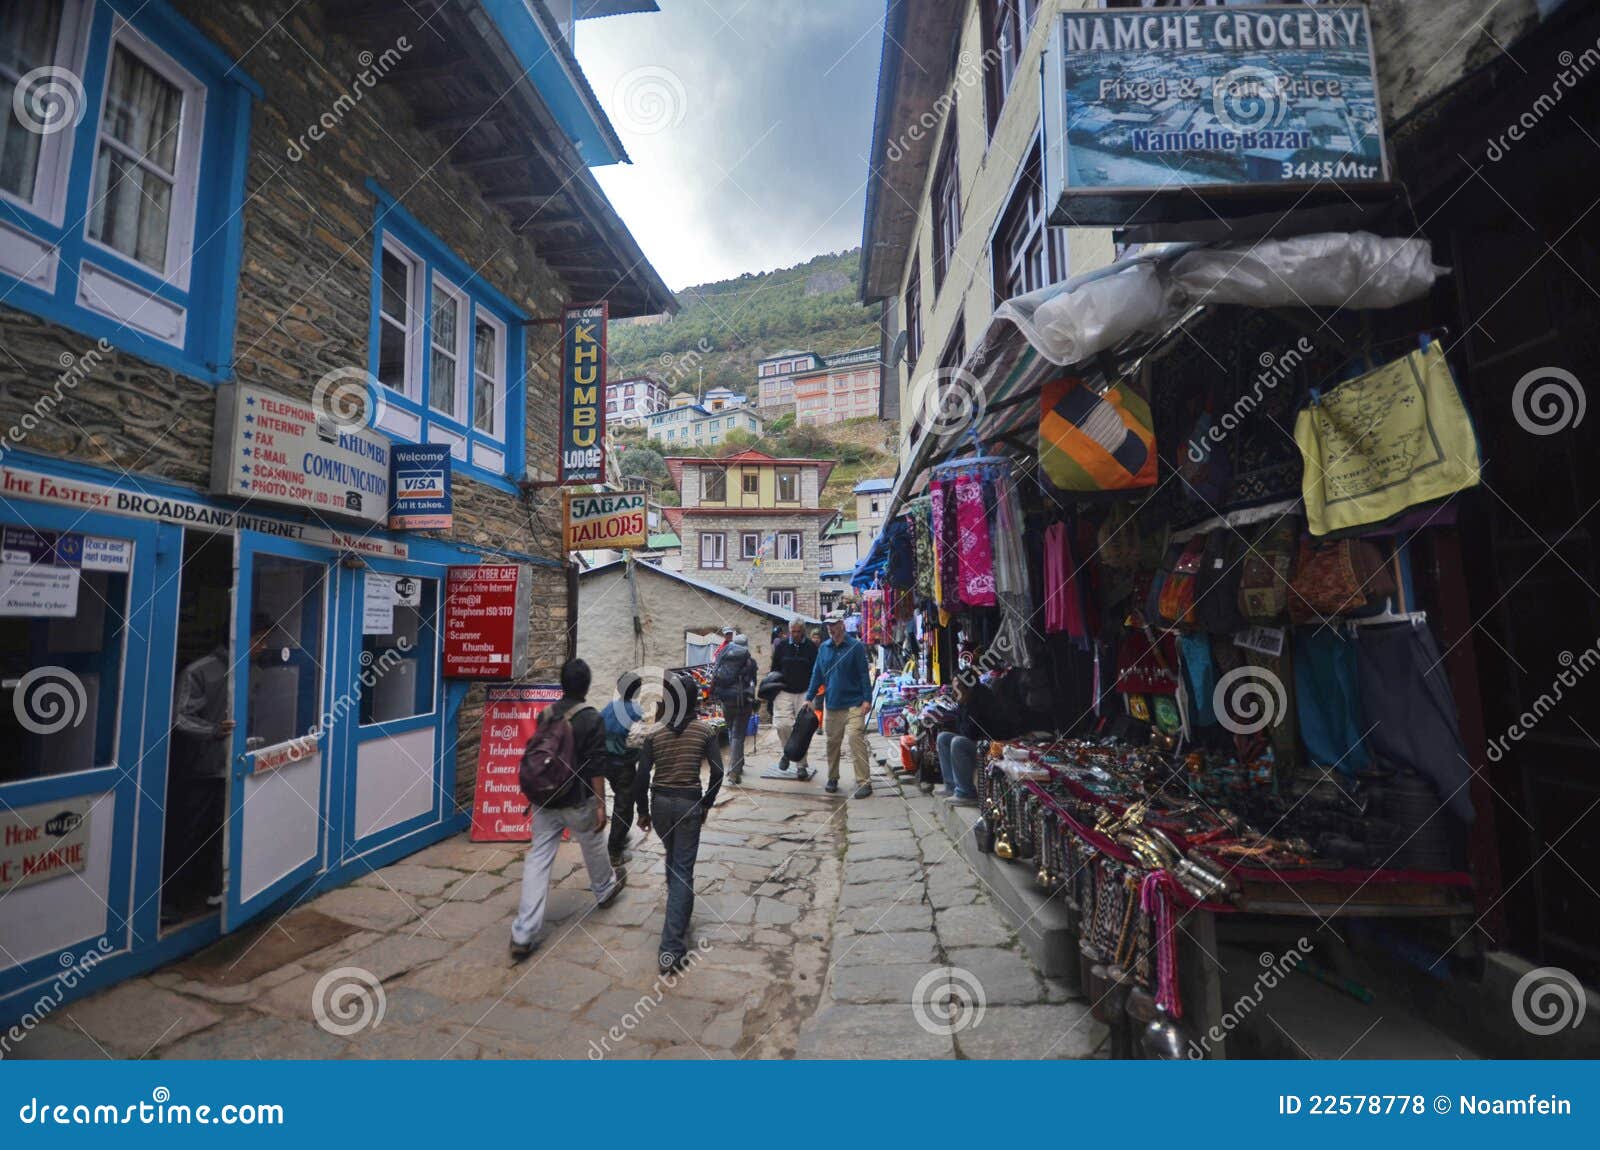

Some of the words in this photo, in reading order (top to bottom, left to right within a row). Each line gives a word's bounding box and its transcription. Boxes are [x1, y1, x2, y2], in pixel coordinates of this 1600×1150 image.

[1066, 14, 1202, 51] NAMCHE
[1214, 12, 1361, 48] GROCERY
[1099, 77, 1174, 100] Fixed
[1178, 77, 1198, 99] &
[1212, 76, 1264, 98] Fair
[1272, 75, 1342, 98] Price
[1133, 129, 1236, 152] Namche
[1241, 130, 1312, 150] Bazar
[1281, 160, 1378, 180] 3445Mtr
[573, 324, 598, 448] KHUMBU
[259, 398, 316, 424] TELEPHONE
[257, 415, 306, 437] INTERNET
[255, 431, 274, 446] FAX
[253, 447, 288, 465] E-MAIL
[338, 430, 388, 467] KHUMBU
[396, 451, 444, 462] Welcome
[564, 448, 602, 469] LODGE
[253, 464, 305, 485] SCANNING
[303, 452, 387, 497] COMMUNICATION
[252, 480, 287, 496] PHOTO
[289, 486, 313, 500] COPY
[404, 479, 437, 490] VISA
[3, 470, 33, 493] THE
[39, 478, 111, 507] FASTEST
[117, 493, 233, 526] BROADBAND
[236, 514, 305, 539] INTERNET
[397, 501, 406, 509] All
[418, 501, 445, 510] takes.
[572, 496, 645, 519] SAGAR
[570, 512, 643, 543] TAILORS
[477, 567, 499, 580] CYBER
[500, 567, 517, 580] CAFE
[489, 583, 513, 593] Internet
[451, 606, 486, 619] Telephone
[449, 619, 464, 628] Fax
[450, 631, 481, 640] Scanner
[462, 642, 495, 652] Khumbu
[447, 654, 488, 663] Communication
[493, 707, 531, 720] Broadband
[490, 724, 519, 741] Em@il
[486, 761, 516, 774] Camera
[484, 780, 521, 795] Photocop
[495, 819, 524, 833] Camera
